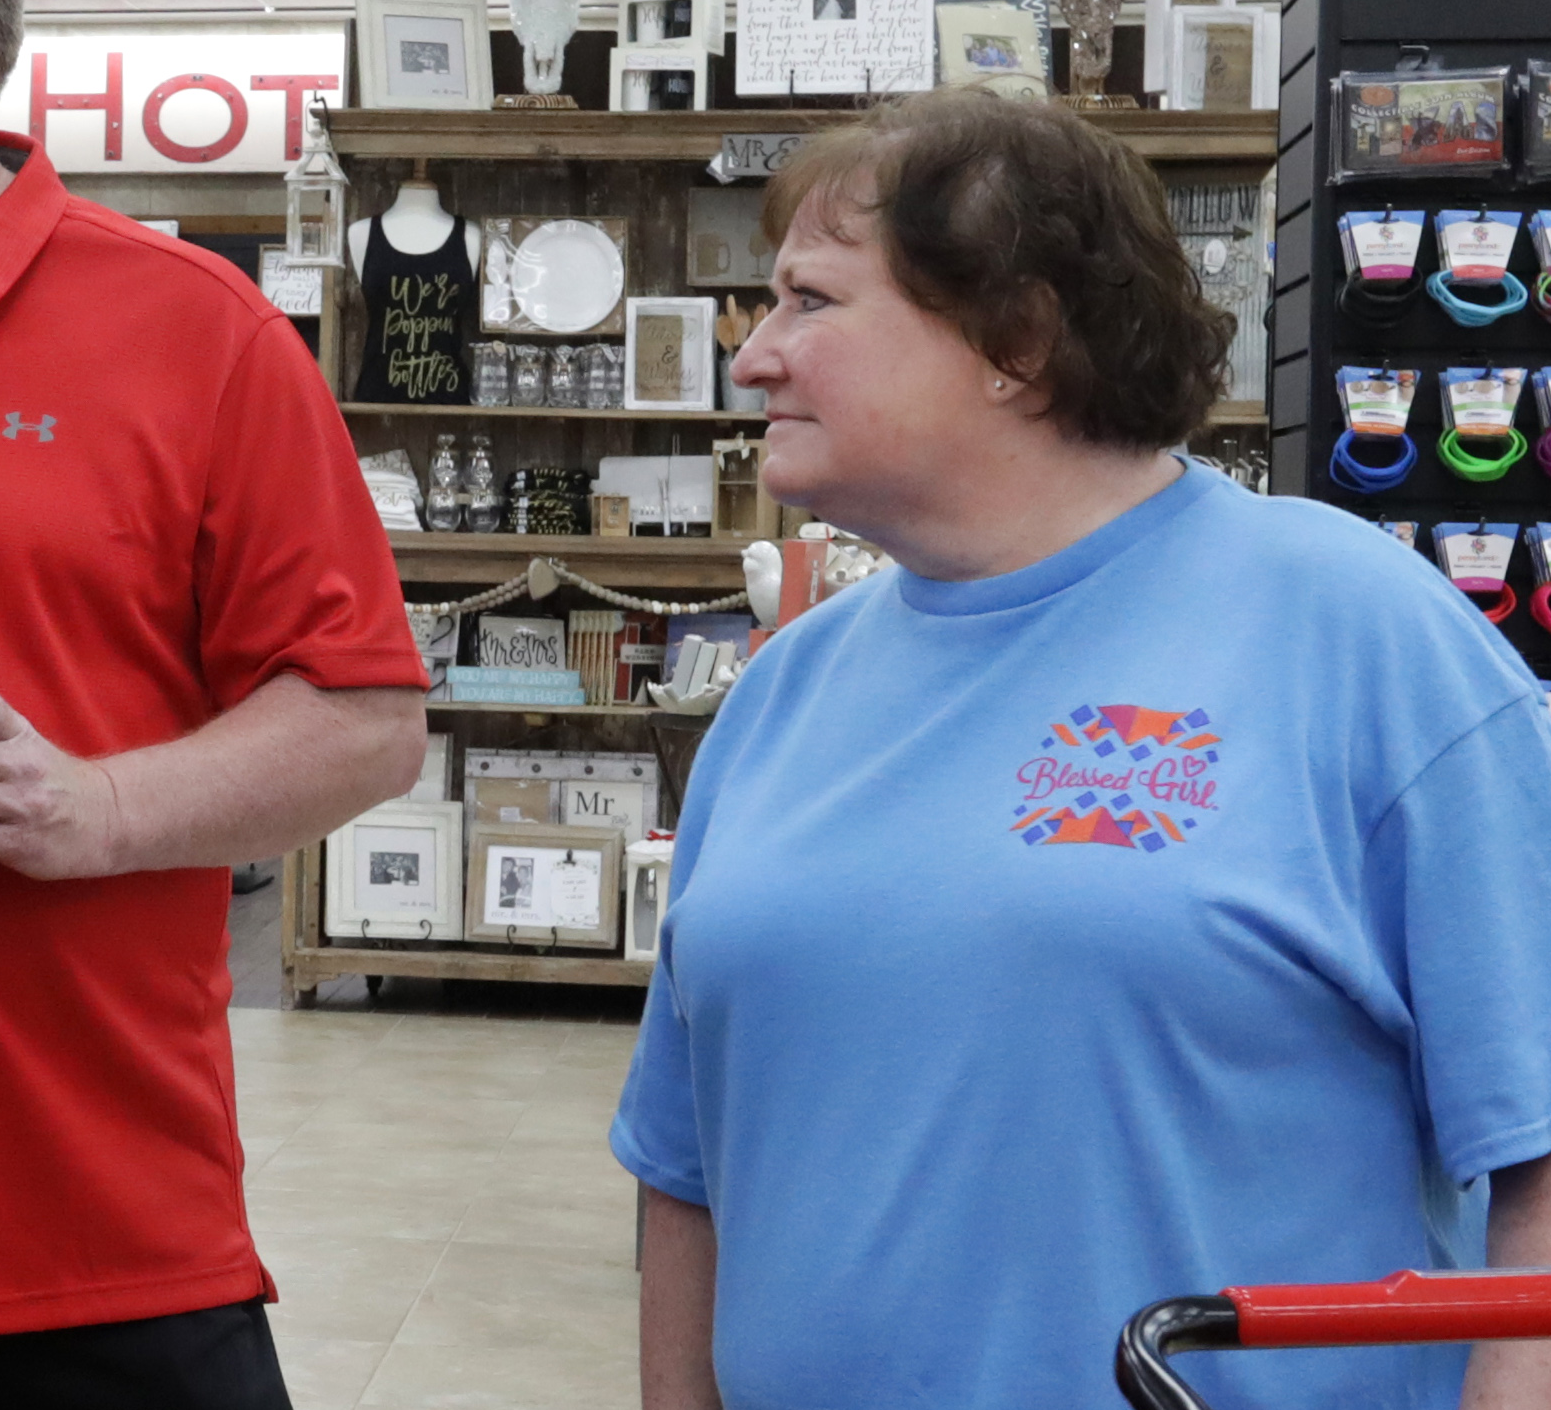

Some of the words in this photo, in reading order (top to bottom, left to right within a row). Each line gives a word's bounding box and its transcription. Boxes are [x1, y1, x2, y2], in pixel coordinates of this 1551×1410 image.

[388, 349, 459, 399] bottles
[575, 791, 614, 816] Mr
[1016, 757, 1134, 800] Blessed
[1138, 756, 1217, 809] Girl
